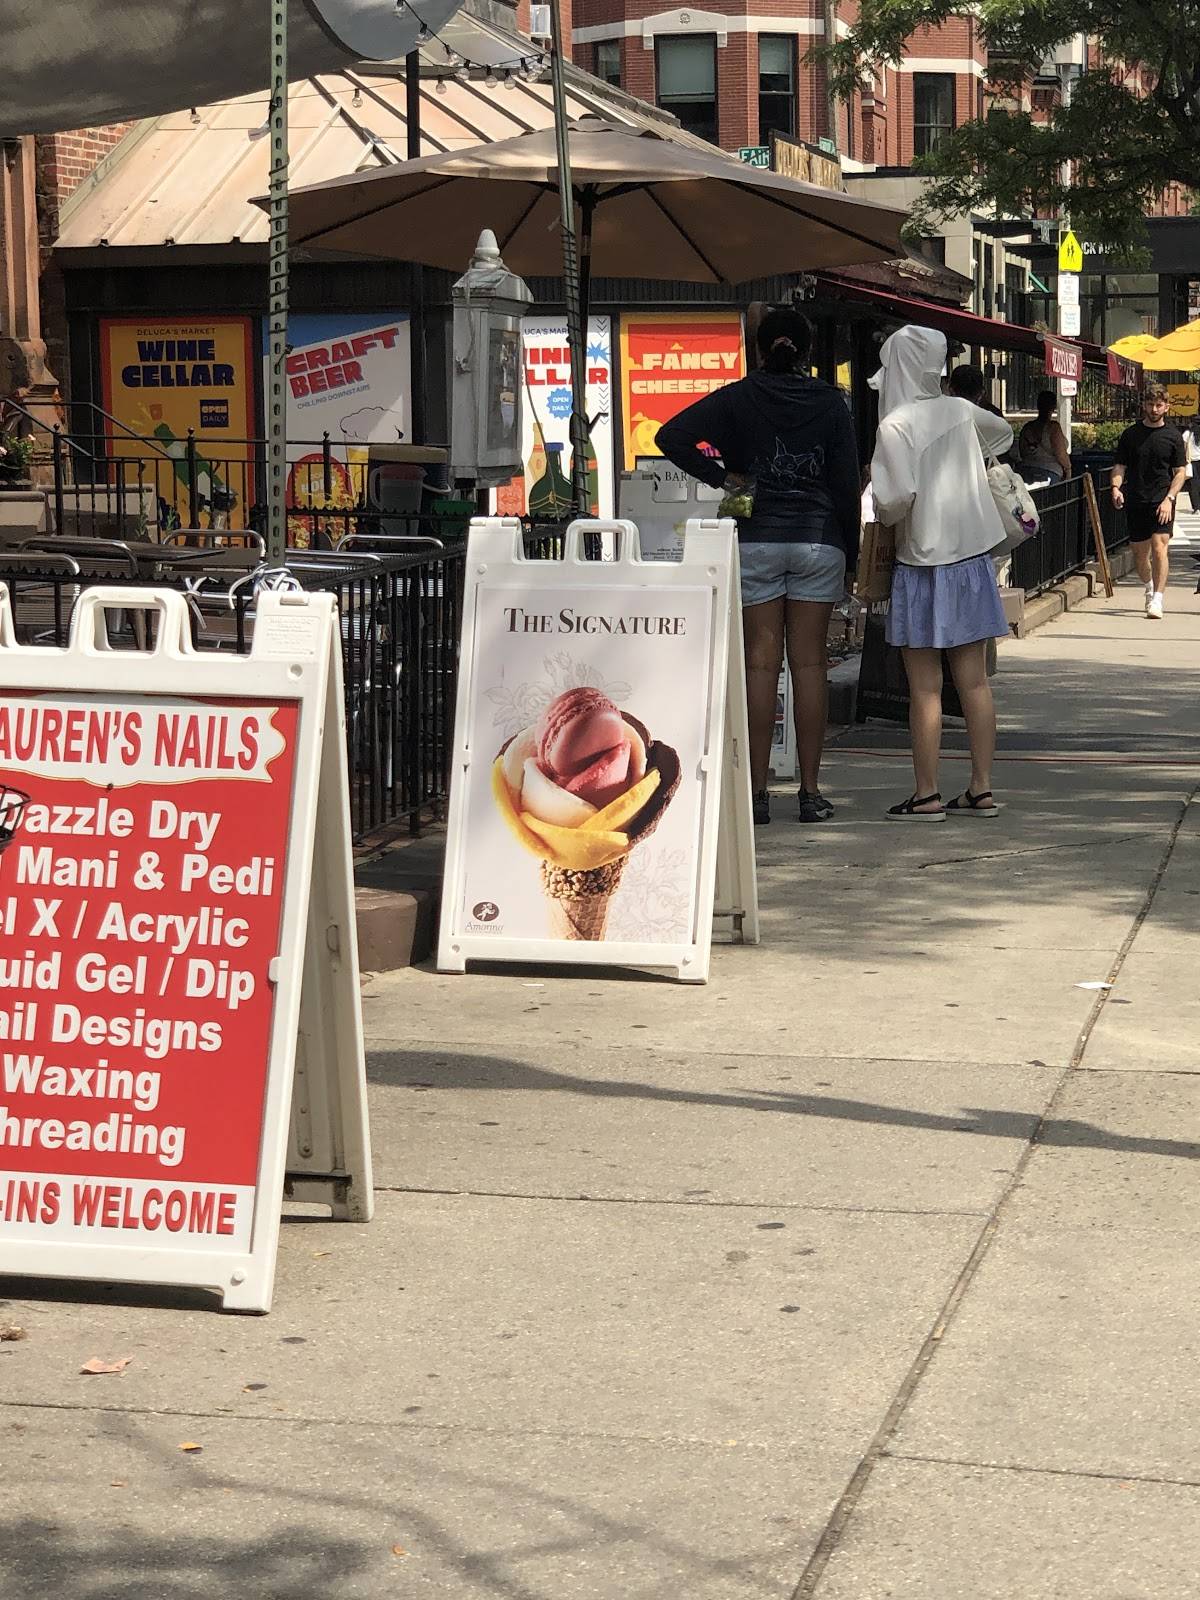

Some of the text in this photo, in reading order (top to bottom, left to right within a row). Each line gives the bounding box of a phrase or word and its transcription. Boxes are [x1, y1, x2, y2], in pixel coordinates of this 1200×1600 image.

[136, 327, 216, 336] DELUCA'S MARKET
[137, 339, 215, 361] WINE
[286, 327, 400, 375] CRAFT
[122, 364, 235, 388] CELLAR
[523, 347, 572, 365] IN
[642, 352, 739, 371] FANCY
[289, 360, 365, 400] BEER
[201, 405, 228, 414] OPEN
[202, 415, 228, 423] DAILY
[503, 607, 686, 636] THE SIGNATURE
[154, 713, 260, 771] NAILS
[148, 800, 222, 851] Dry
[16, 845, 275, 896] Mani & Pedi
[29, 898, 63, 938] X
[72, 900, 88, 939] /
[96, 902, 250, 954] Acrylic
[75, 952, 148, 995] Gel
[158, 956, 175, 997] /
[185, 958, 256, 1010] Dip
[50, 1003, 223, 1059] Designs
[3, 1053, 162, 1112] Waxing
[73, 1183, 238, 1236] WELCOME
